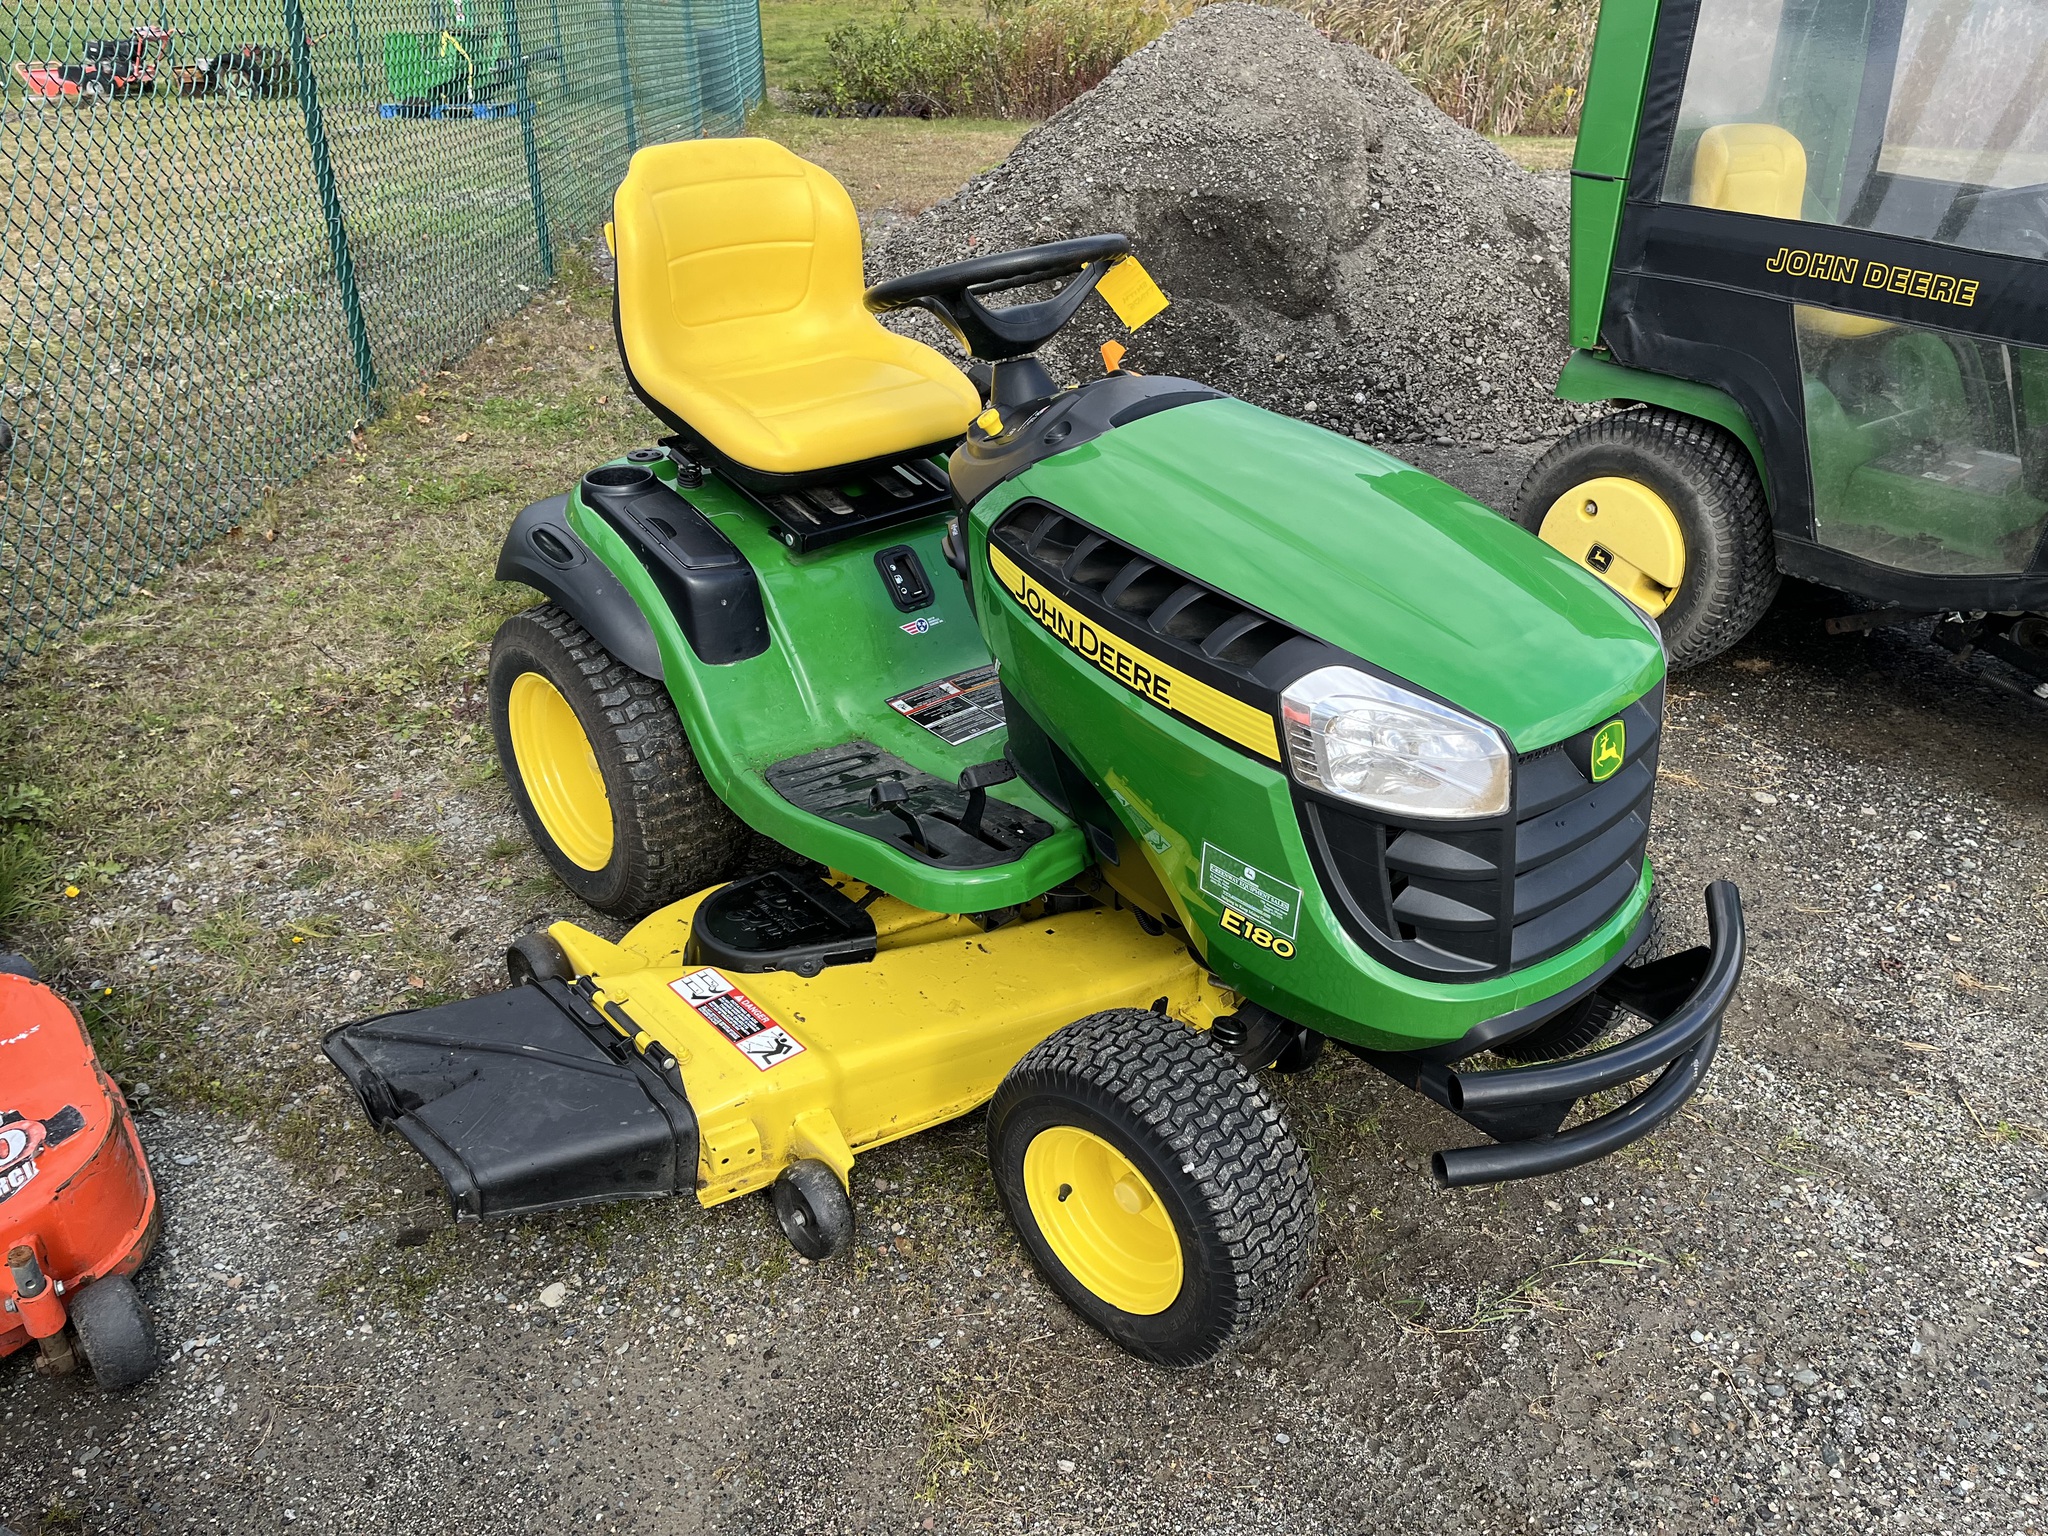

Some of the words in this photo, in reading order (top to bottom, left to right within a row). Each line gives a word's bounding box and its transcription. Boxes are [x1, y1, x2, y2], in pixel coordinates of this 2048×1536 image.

[1766, 247, 1859, 284] JOHN
[1862, 261, 1979, 307] DEERE
[1015, 575, 1074, 642] JOHN
[1079, 621, 1172, 705] DEERE
[1220, 907, 1294, 958] E180
[740, 999, 770, 1023] DANGER
